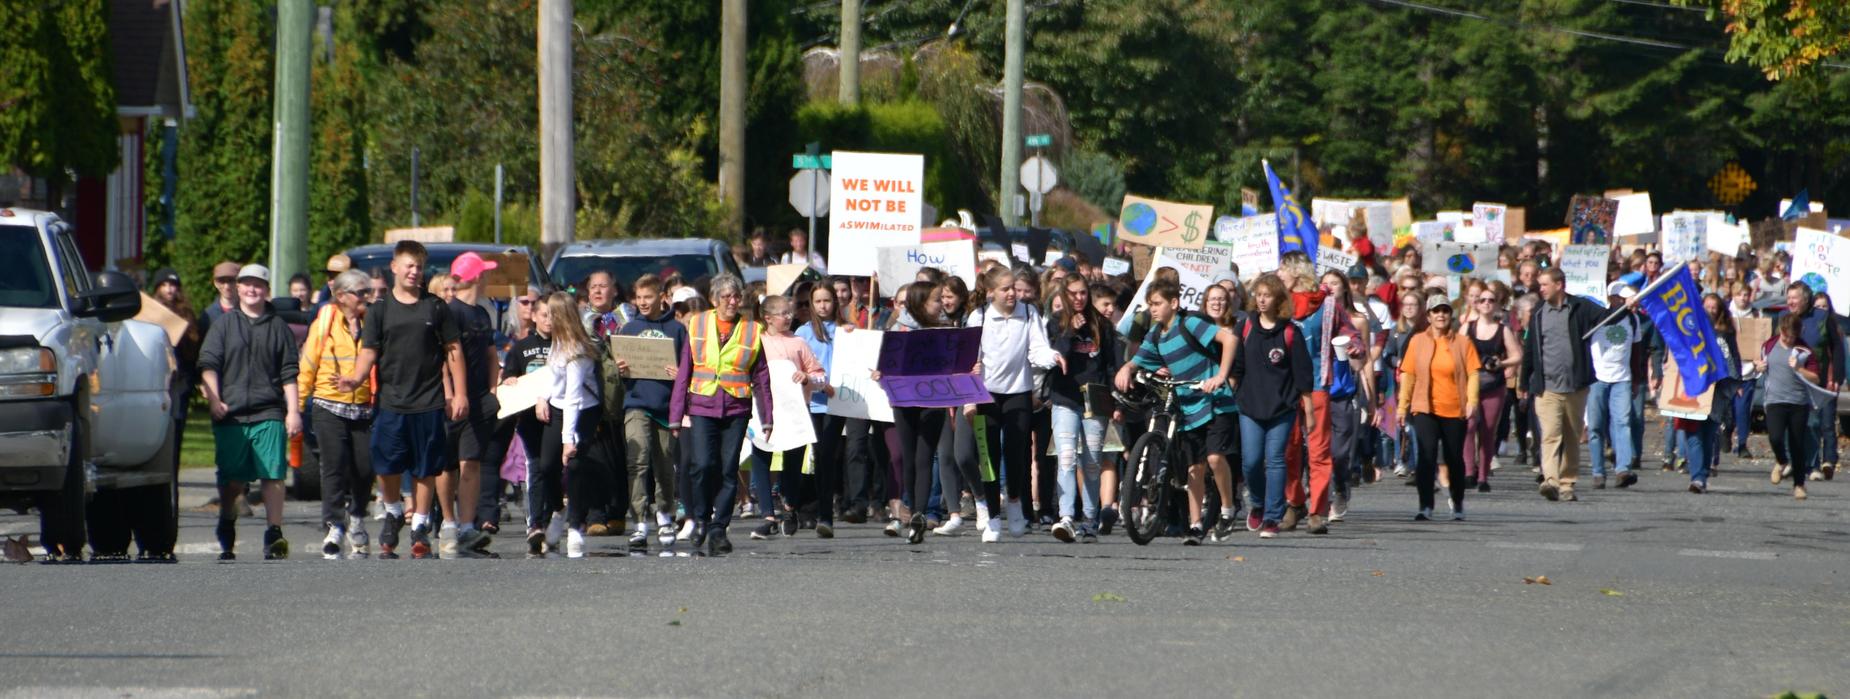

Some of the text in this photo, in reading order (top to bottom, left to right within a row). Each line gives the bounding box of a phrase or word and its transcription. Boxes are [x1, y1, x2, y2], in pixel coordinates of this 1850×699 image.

[842, 178, 915, 193] WE WILL
[846, 199, 906, 213] NOT BE
[1176, 252, 1219, 265] CHILDREN
[523, 347, 541, 358] EAST
[887, 376, 983, 400] FOOL!
